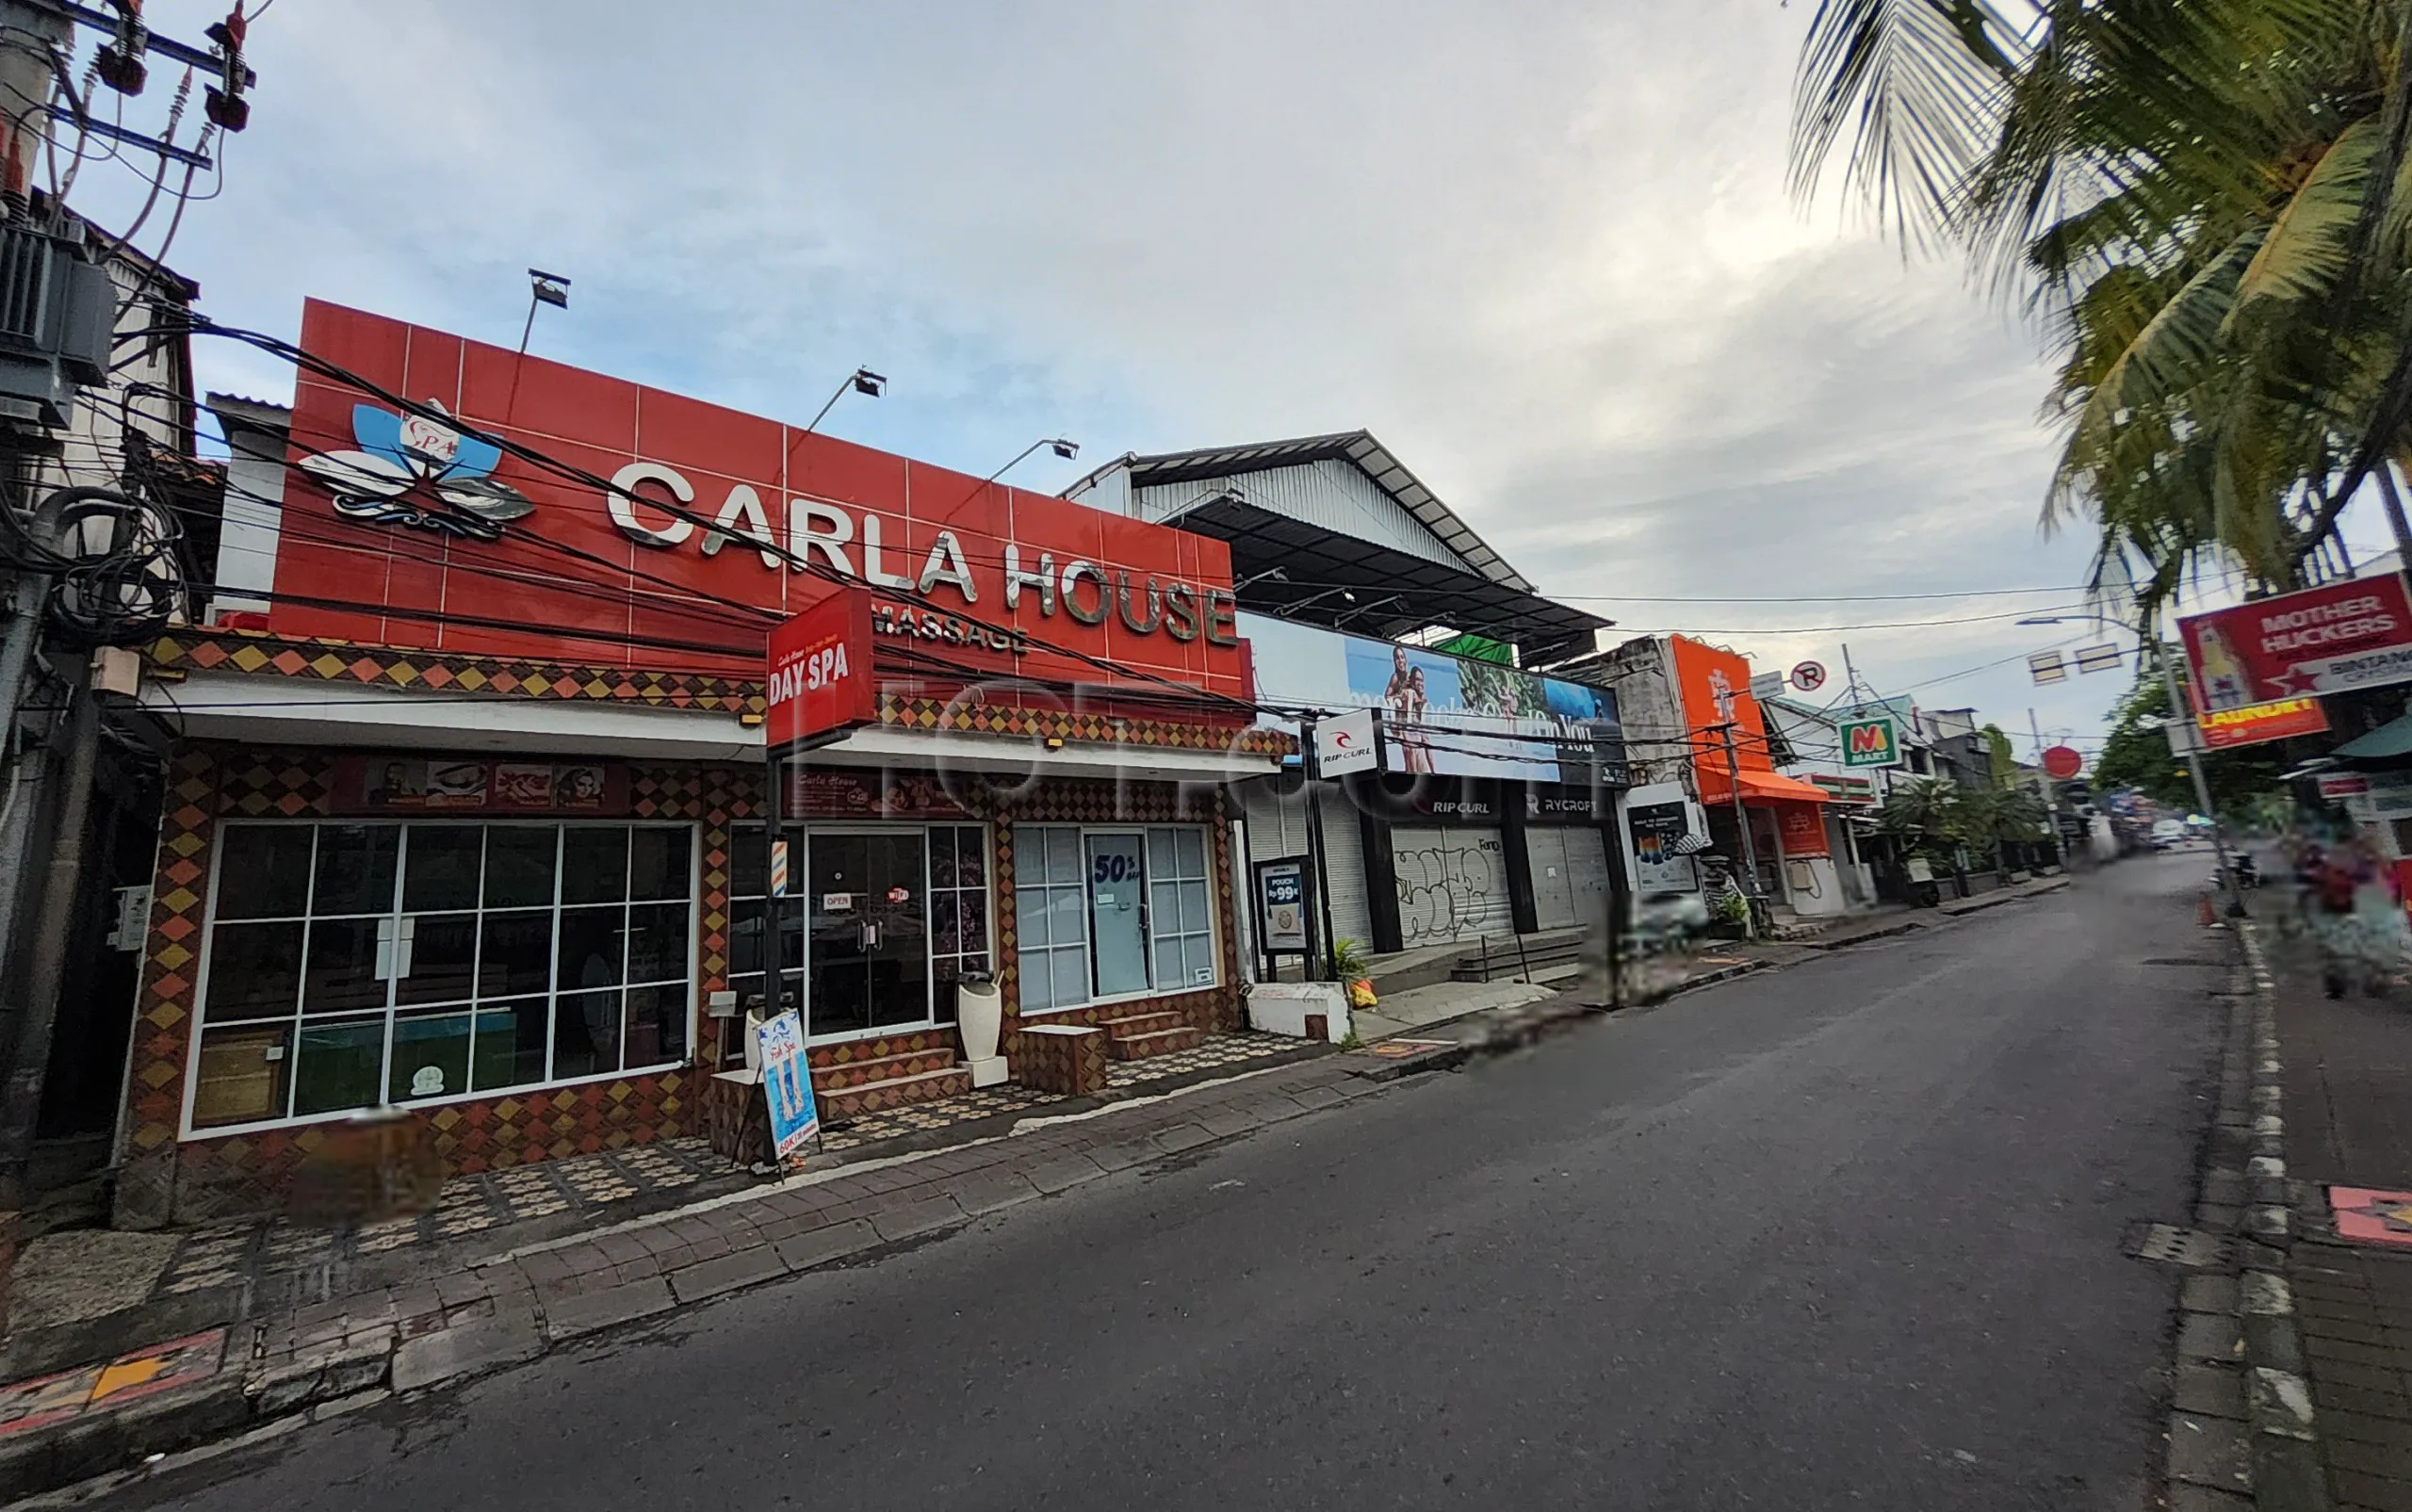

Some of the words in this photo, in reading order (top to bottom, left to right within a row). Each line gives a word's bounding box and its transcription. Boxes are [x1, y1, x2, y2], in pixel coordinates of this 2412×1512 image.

[607, 461, 978, 604] CARLA
[1004, 543, 1241, 647] HOUSE
[2260, 595, 2384, 633] MOTHER
[2260, 613, 2398, 653] HUCKERS
[769, 659, 806, 707] DAY
[807, 642, 848, 691] SPA
[1323, 752, 1343, 764] RIP
[1344, 747, 1373, 759] CURL
[1432, 802, 1455, 813] RIP
[1458, 802, 1491, 814] CURL
[1544, 799, 1598, 812] RYCROFT
[1272, 877, 1295, 886] POUCH
[826, 896, 849, 905] OPEN
